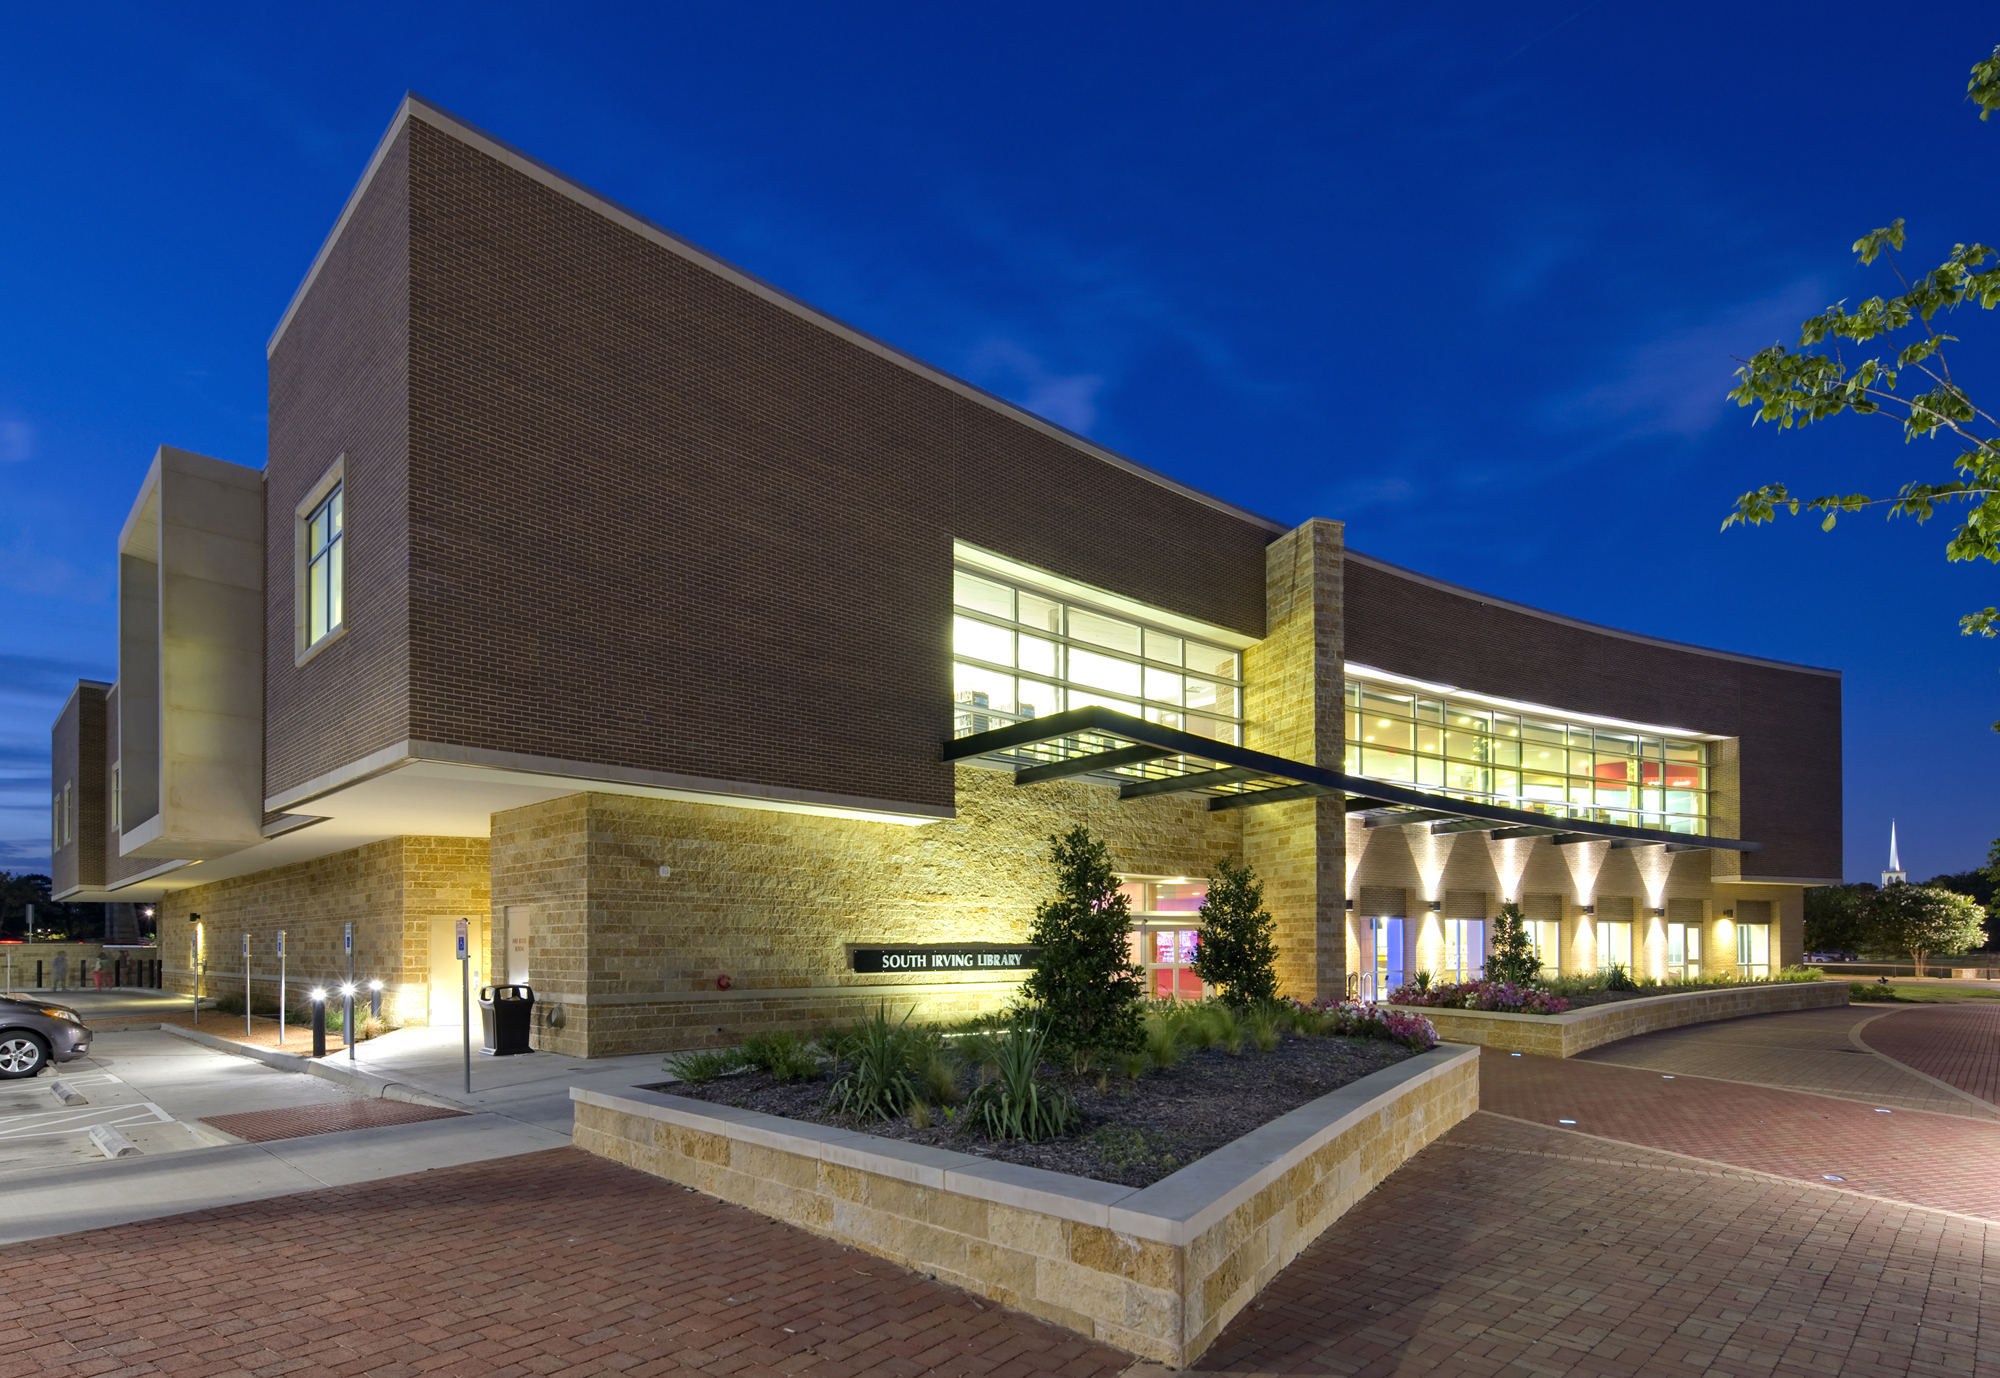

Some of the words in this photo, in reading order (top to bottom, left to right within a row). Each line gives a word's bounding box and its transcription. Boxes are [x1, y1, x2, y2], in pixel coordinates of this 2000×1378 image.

[882, 954, 927, 968] SOUTH
[931, 954, 973, 967] IRVING
[977, 953, 1023, 966] LIBRARY
